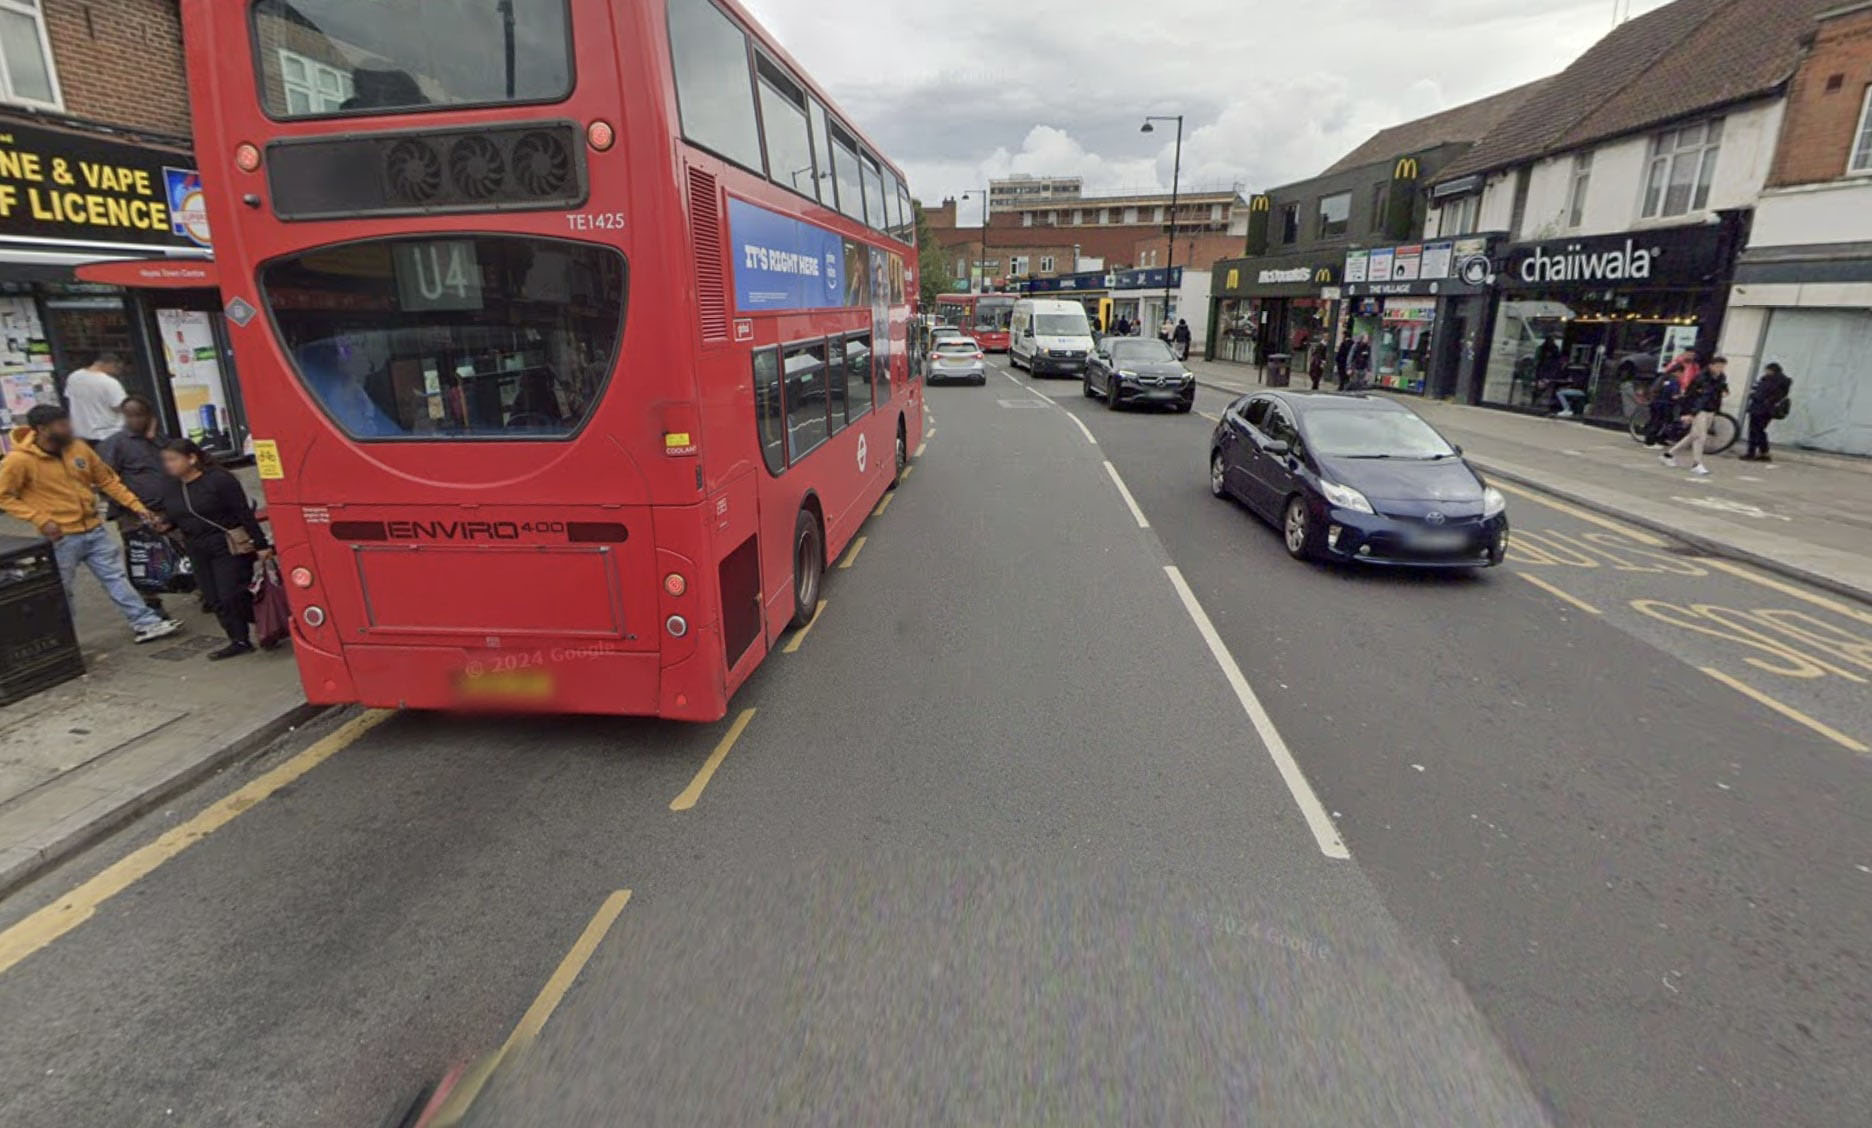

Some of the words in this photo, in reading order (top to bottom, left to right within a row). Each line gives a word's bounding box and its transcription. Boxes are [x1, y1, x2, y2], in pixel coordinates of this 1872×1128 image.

[52, 157, 74, 185] &
[79, 161, 153, 195] VAPE
[28, 188, 169, 231] LICENCE
[566, 212, 625, 230] TE1425
[413, 245, 469, 299] U4
[744, 244, 768, 271] IT'S
[768, 249, 799, 274] RIGHT
[799, 255, 819, 276] HERE
[1521, 238, 1650, 282] chaiiwala
